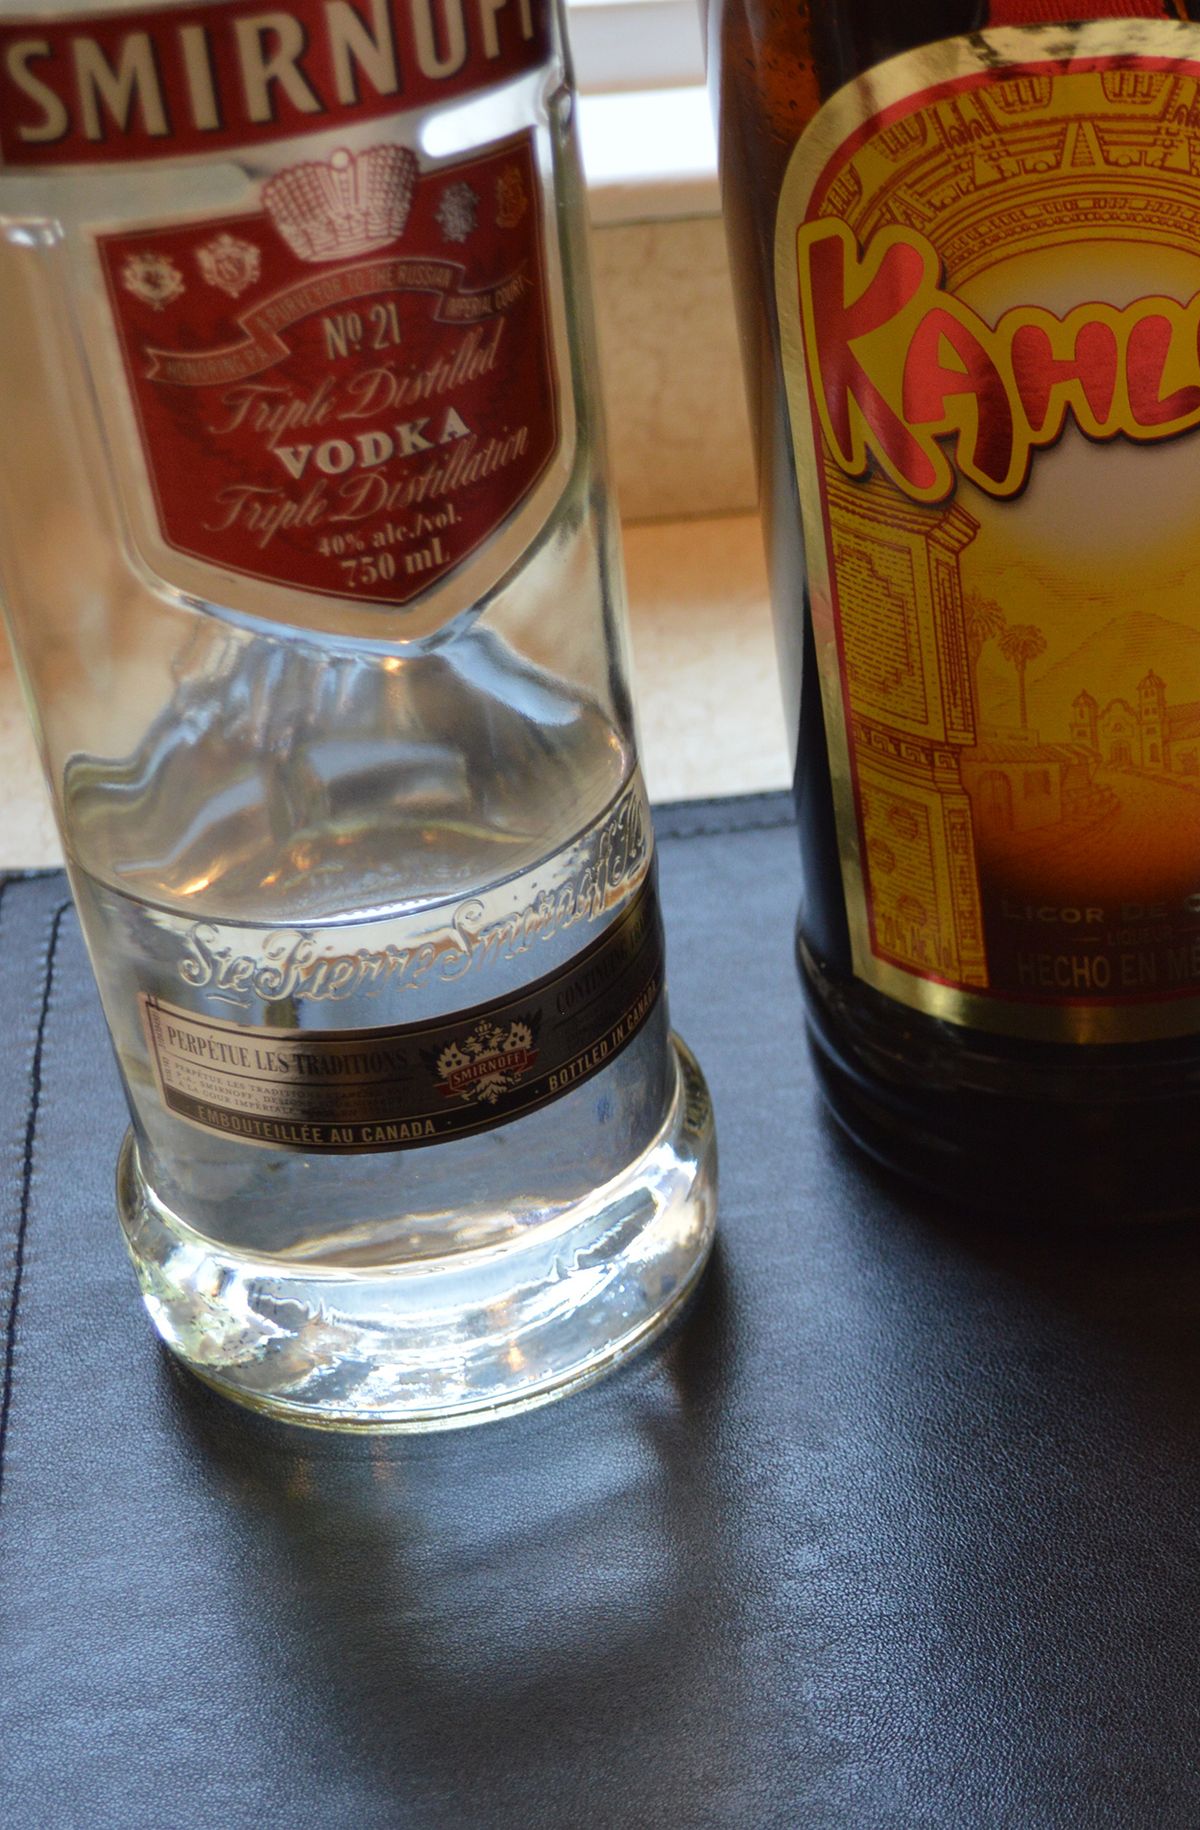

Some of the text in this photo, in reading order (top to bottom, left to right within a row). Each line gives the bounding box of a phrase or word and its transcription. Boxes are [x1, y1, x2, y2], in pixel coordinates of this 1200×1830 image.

[397, 266, 452, 289] RUSSIAN
[370, 303, 401, 350] 21
[208, 316, 505, 450] Triple Distilled
[273, 406, 472, 480] VODKA
[204, 426, 528, 549] Triple Distillation
[318, 536, 365, 558] 40%
[340, 553, 396, 587] 750
[1001, 899, 1105, 924] LICOR
[1017, 951, 1111, 989] HECHO
[1121, 952, 1157, 986] EN
[167, 1025, 408, 1076] PERPÉTUE LES TRADITIONS
[453, 1053, 522, 1085] SMIRNOFF
[548, 1040, 608, 1092] BOTTLED
[612, 1026, 626, 1048] IN
[198, 1104, 322, 1143] EMBOUTEILLÉE
[331, 1128, 353, 1143] AU
[361, 1118, 436, 1142] CANADA
